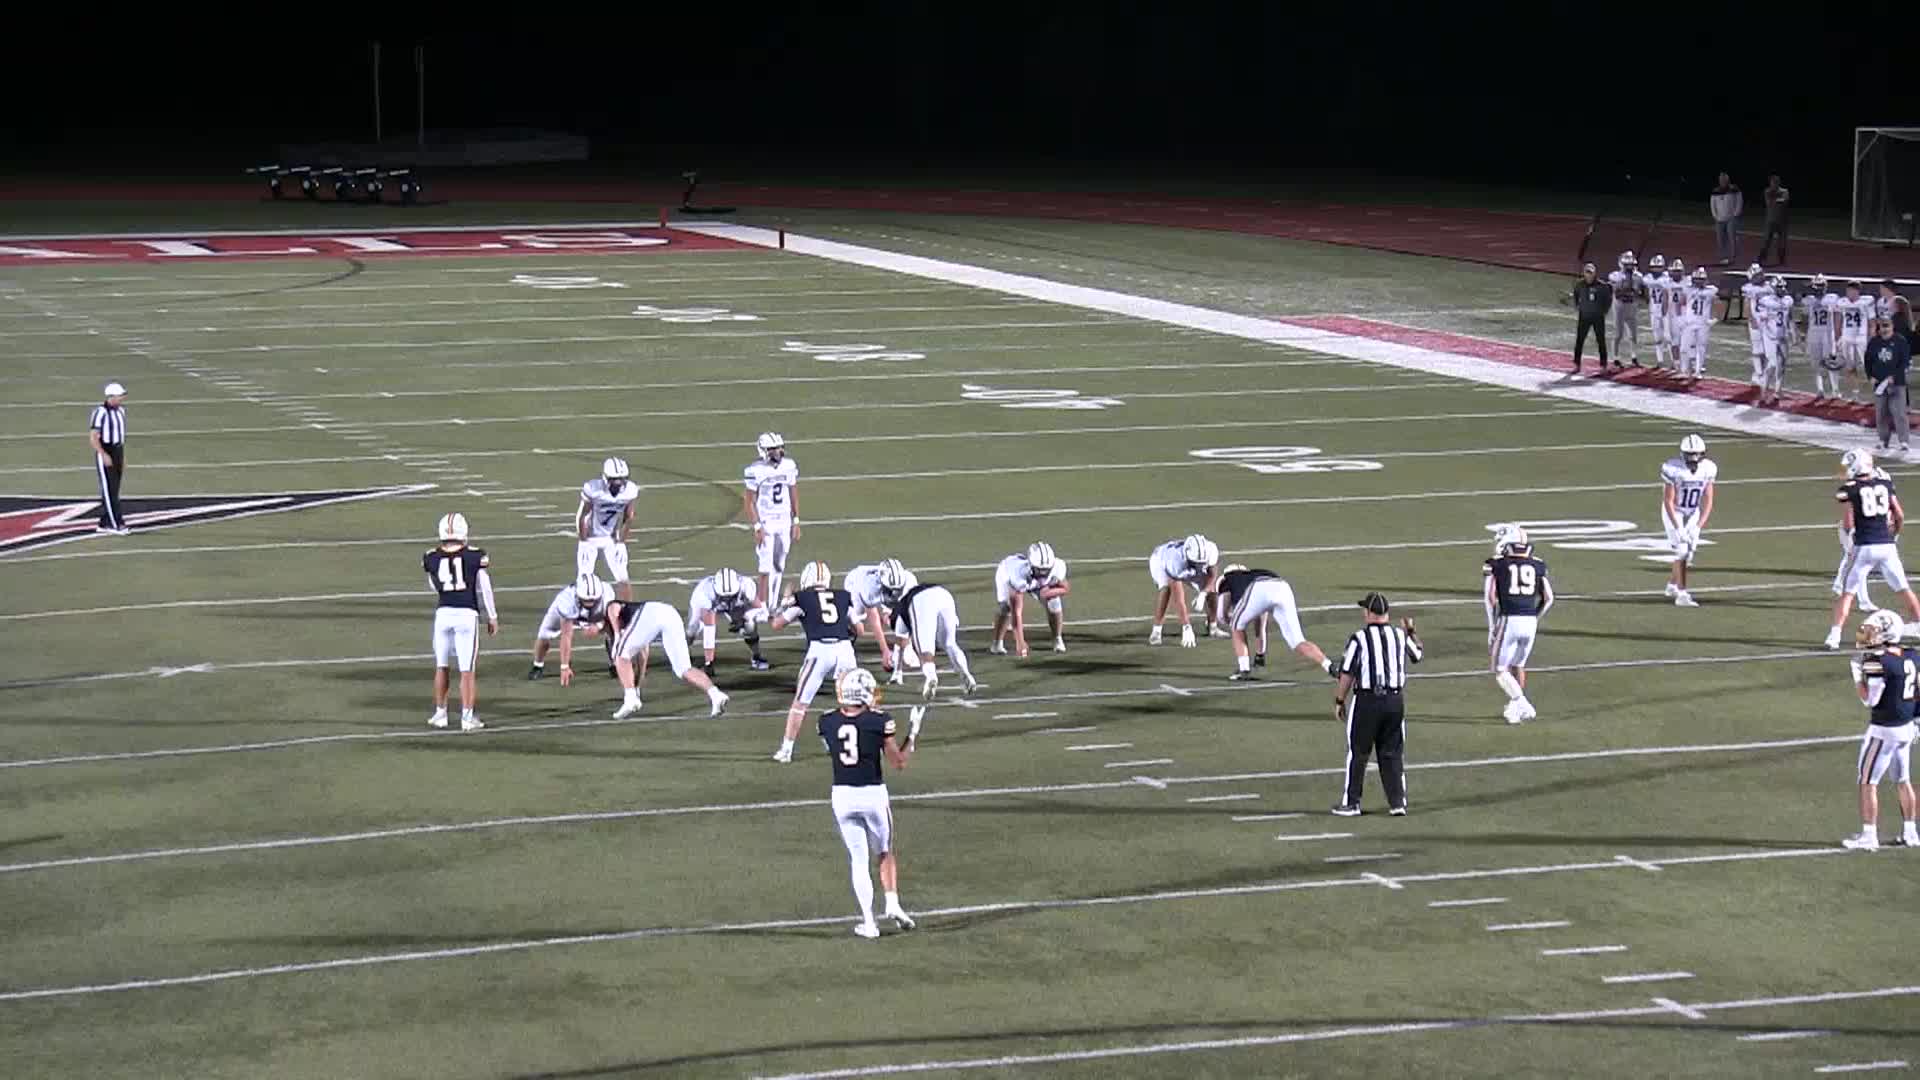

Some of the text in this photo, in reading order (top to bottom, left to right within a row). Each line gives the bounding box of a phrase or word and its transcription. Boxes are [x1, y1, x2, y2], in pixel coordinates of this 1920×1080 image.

[1691, 300, 1704, 316] 41
[1814, 310, 1828, 325] 12
[1775, 311, 1784, 327] 3
[1845, 311, 1861, 328] 24
[773, 482, 783, 504] 2
[1680, 488, 1701, 508] 10
[1859, 484, 1889, 517] 83
[601, 510, 617, 526] 7
[438, 557, 466, 591] 41
[1508, 564, 1536, 595] 19
[818, 592, 839, 623] 5
[838, 723, 859, 766] 3
